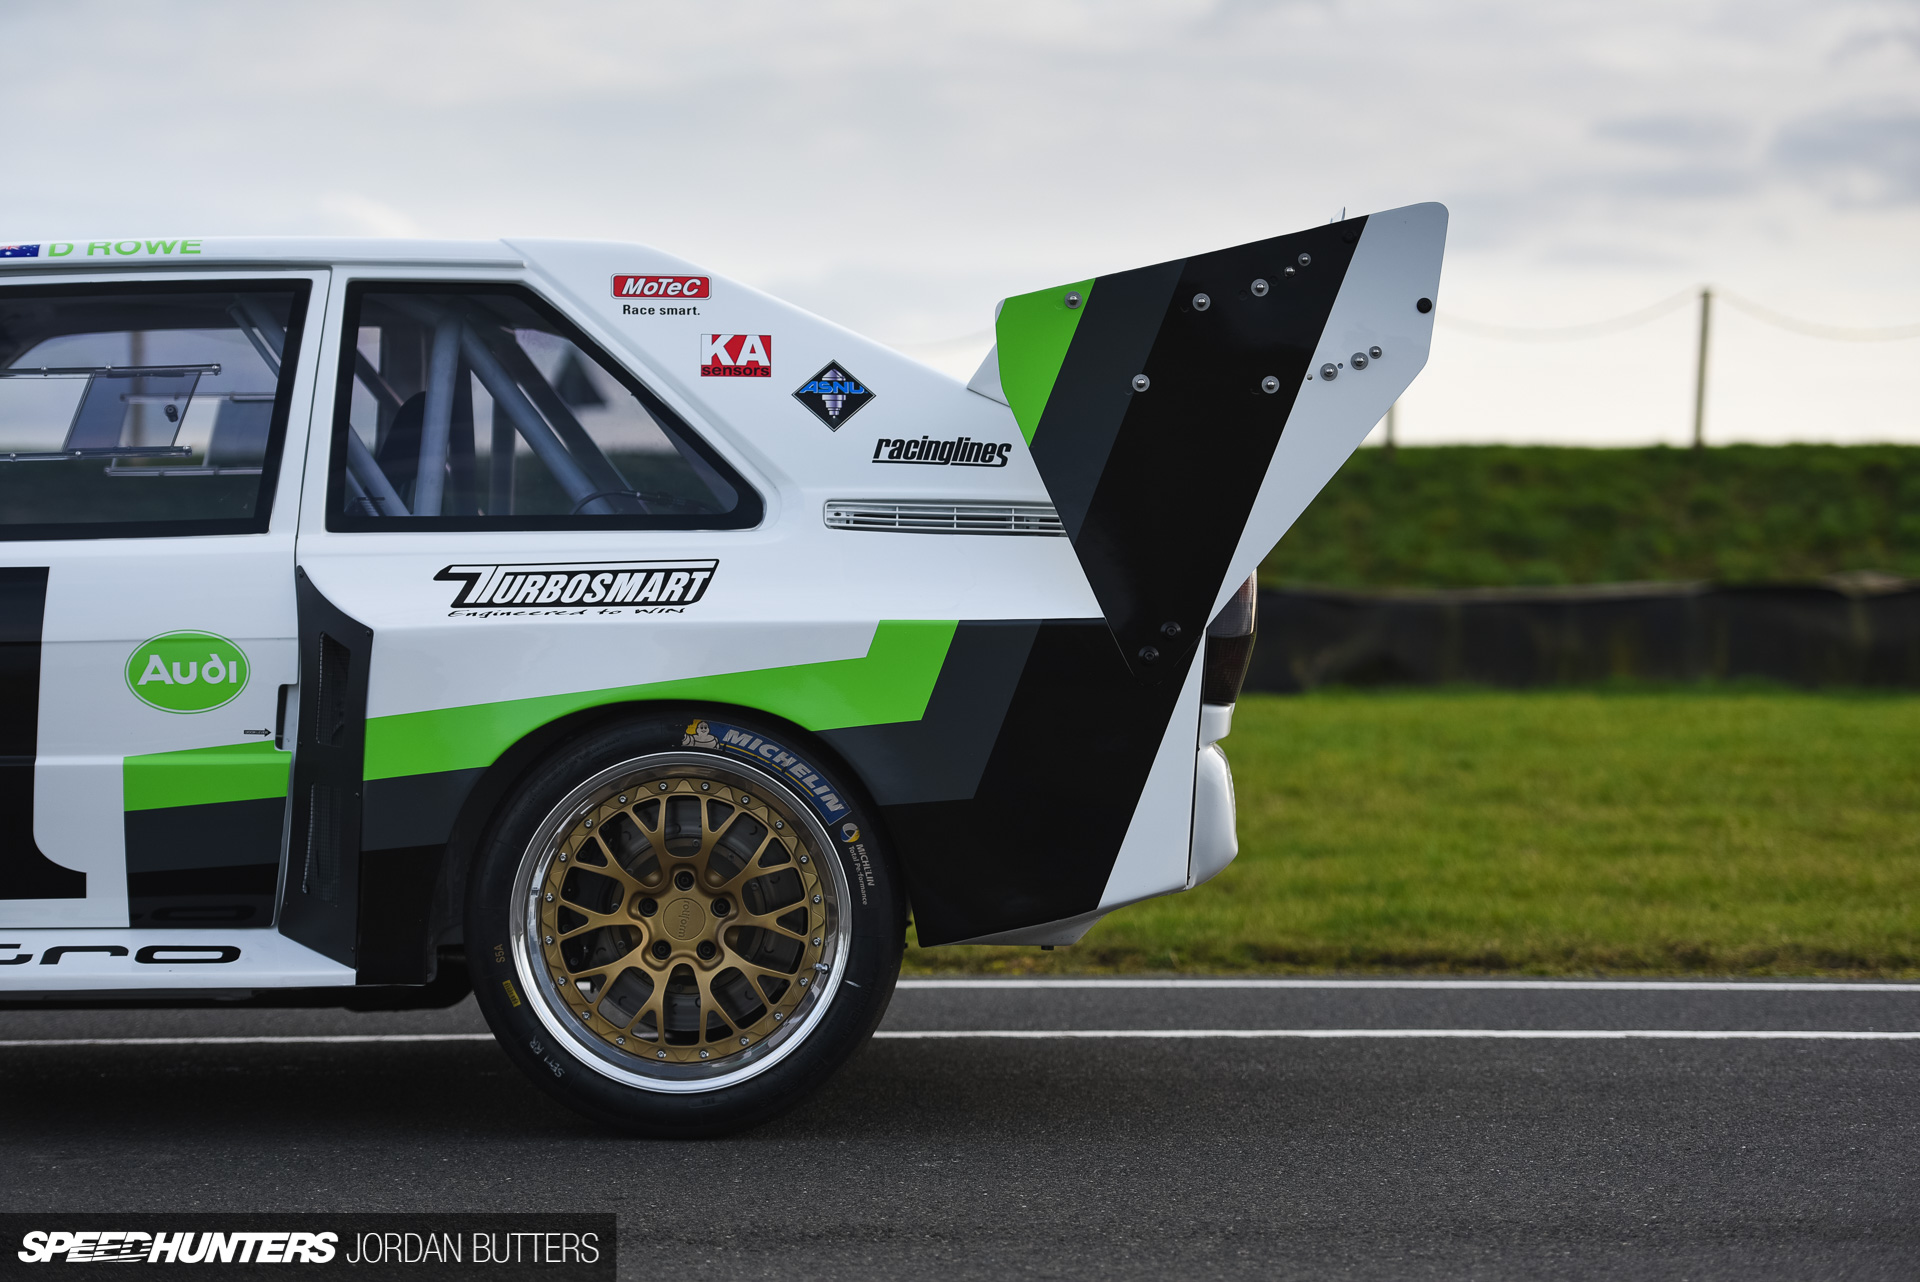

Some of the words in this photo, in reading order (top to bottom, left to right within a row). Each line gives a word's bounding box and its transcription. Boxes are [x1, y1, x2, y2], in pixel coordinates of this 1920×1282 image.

[48, 242, 74, 257] D
[86, 239, 203, 256] ROWE
[621, 278, 701, 296] MoTeC
[622, 304, 655, 316] Race
[659, 305, 700, 316] smart.
[701, 334, 771, 366] KA
[701, 366, 770, 377] sensors
[799, 381, 866, 394] ASNU
[872, 436, 1012, 467] racinglines
[445, 560, 718, 604] TURBOSMART
[447, 609, 588, 618] Engineered
[137, 653, 237, 685] Audi
[722, 729, 845, 812] MICHELIN
[848, 845, 860, 862] Total
[494, 944, 505, 963] S5A
[529, 1035, 544, 1055] RR
